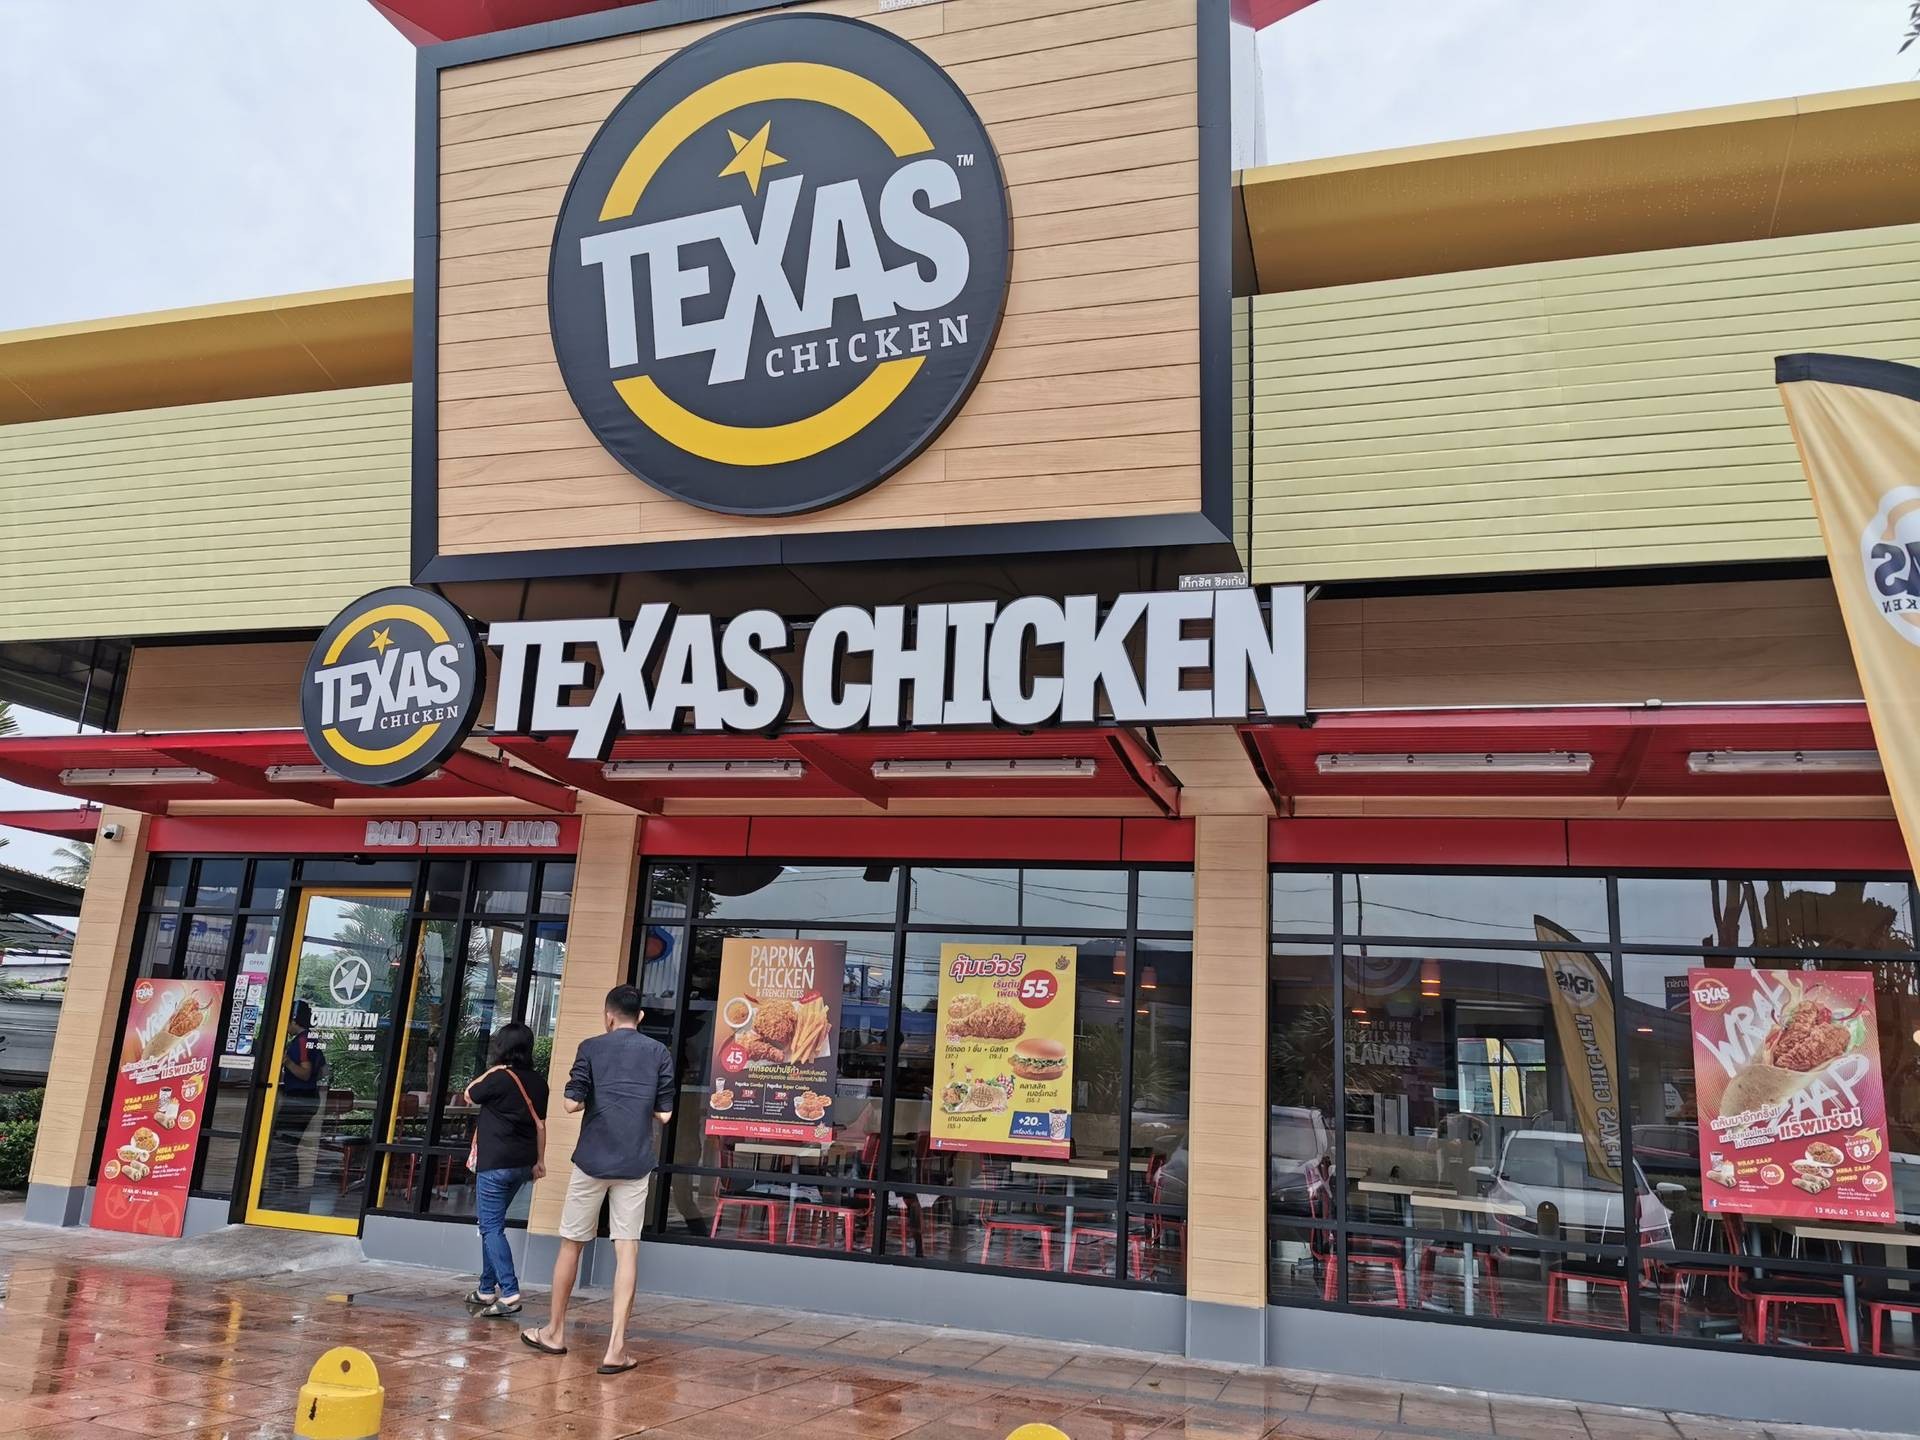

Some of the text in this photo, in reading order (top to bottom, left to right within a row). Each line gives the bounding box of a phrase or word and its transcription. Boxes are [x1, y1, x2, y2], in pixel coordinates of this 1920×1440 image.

[580, 158, 970, 385] TEXAS
[766, 315, 969, 378] CHICKEN
[488, 585, 1306, 760] TEXAS CHICKEN
[314, 643, 461, 732] TEXAS
[380, 705, 459, 730] CHICKEN
[365, 821, 560, 847] BOLD TEXAS FLAVOR
[750, 945, 815, 968] PAPRIKA
[950, 953, 1026, 982] คุ้มเว่อร์
[749, 967, 815, 989] CHICKEN
[1692, 986, 1730, 1007] TEXAS
[310, 1011, 379, 1028] COME ON IN
[727, 1051, 743, 1065] 45
